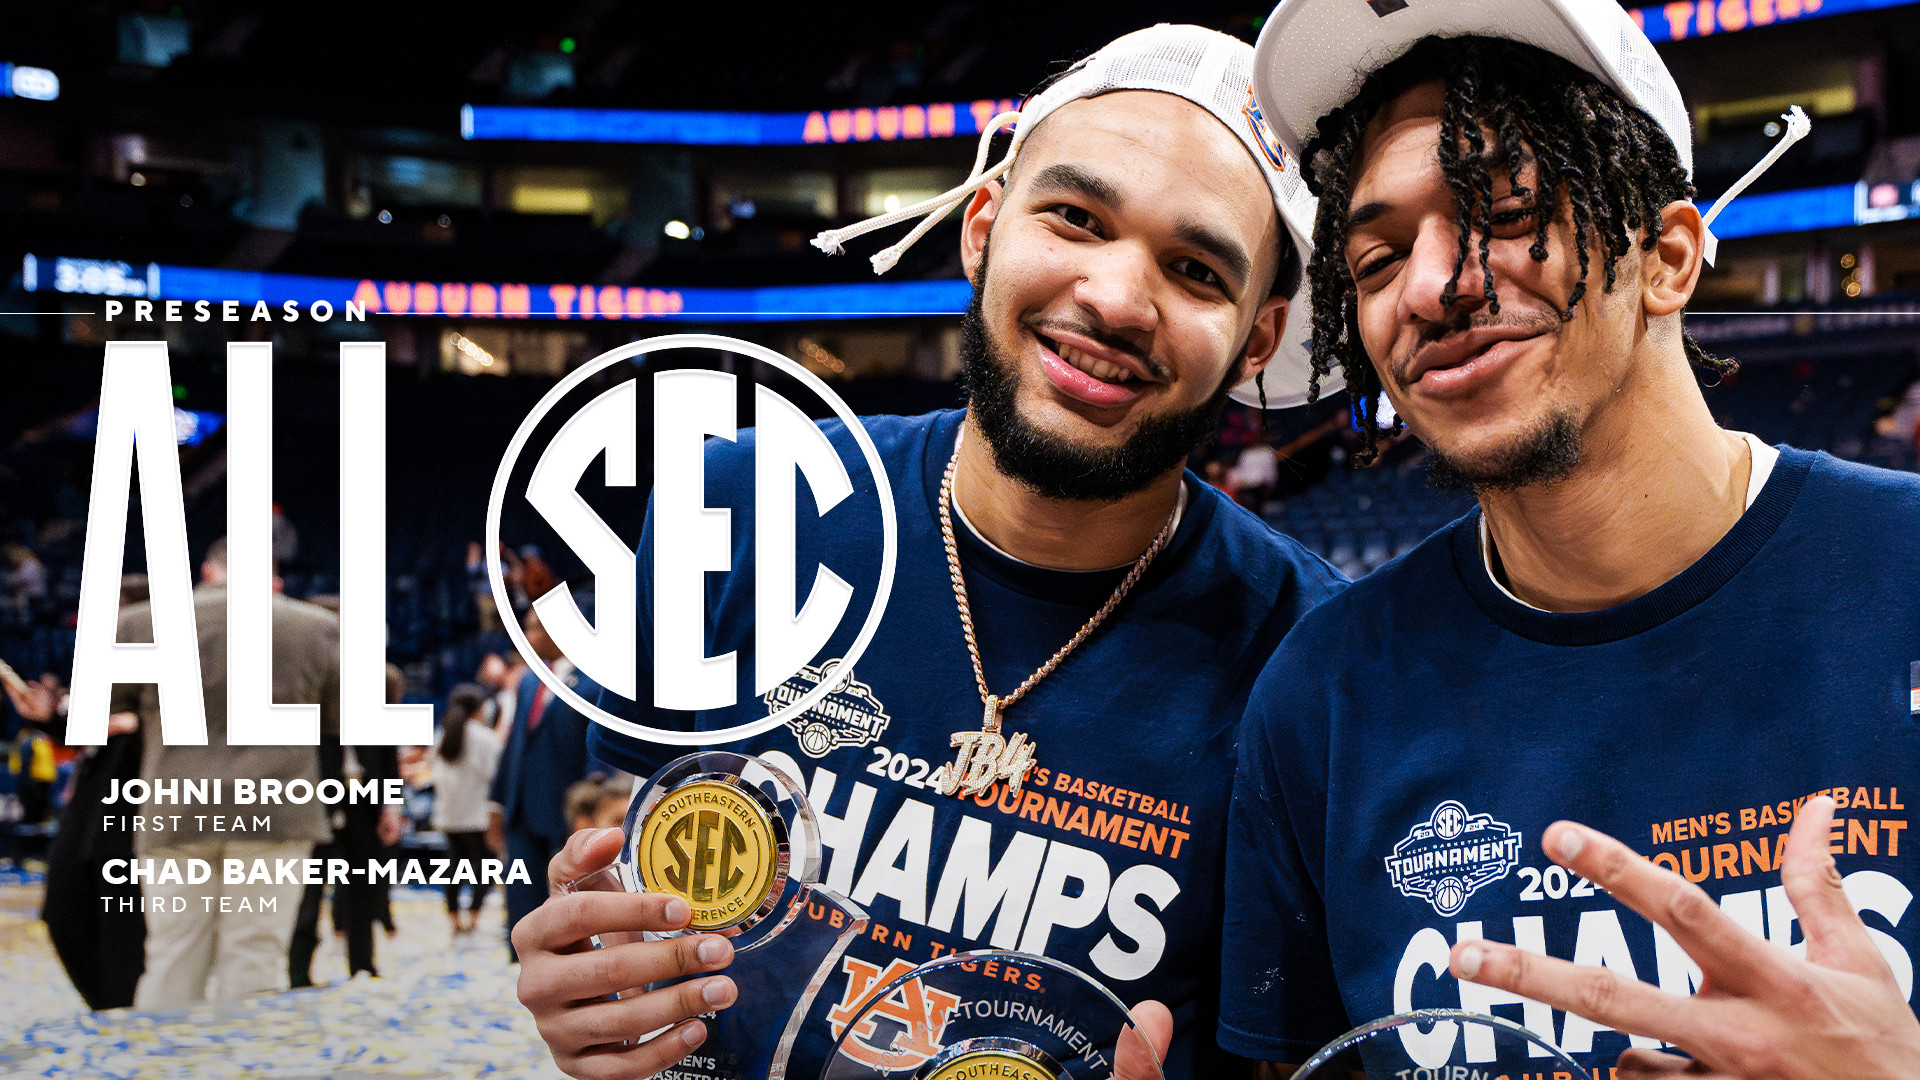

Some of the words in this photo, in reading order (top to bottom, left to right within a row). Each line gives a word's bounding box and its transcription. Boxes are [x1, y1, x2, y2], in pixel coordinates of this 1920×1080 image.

[766, 684, 885, 737] OUNAMENT
[866, 746, 944, 795] 2024
[661, 791, 757, 830] SOUTHEASTERN
[957, 774, 1190, 859] OURNAMENT
[1054, 772, 1192, 826] BASKETBALL
[1740, 786, 1905, 831] BASKBALL
[1436, 808, 1463, 838] SEC
[663, 808, 748, 902] SEC
[1391, 838, 1517, 882] TOURNAMENT
[1516, 864, 1612, 902] 202
[690, 894, 746, 923] ERENCE
[678, 1055, 716, 1070] EN'S
